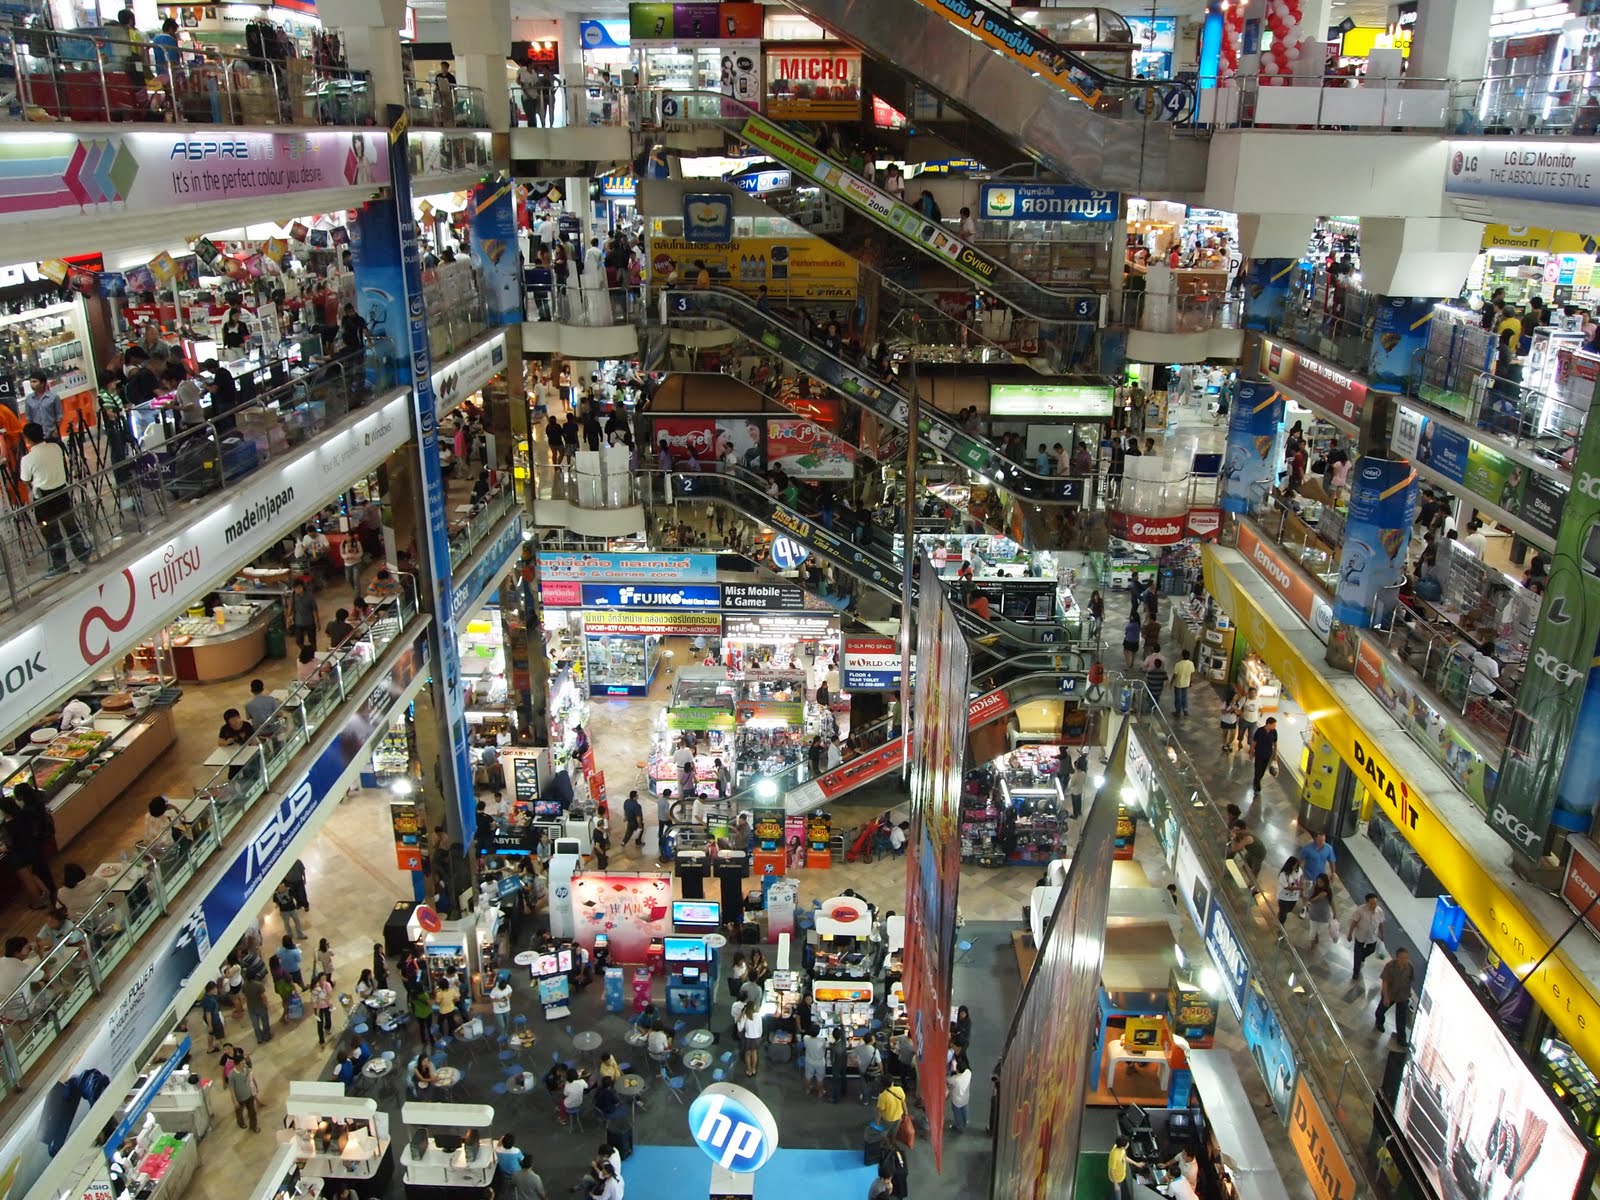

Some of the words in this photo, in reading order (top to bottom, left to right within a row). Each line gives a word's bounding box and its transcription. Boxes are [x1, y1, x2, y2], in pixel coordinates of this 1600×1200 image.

[972, 10, 985, 26] 1
[1400, 11, 1417, 24] leno
[780, 58, 848, 79] MICRO
[664, 103, 674, 114] 4
[1169, 94, 1180, 110] 4
[171, 142, 249, 160] ASPIRE
[1504, 151, 1517, 165] LG
[1537, 152, 1576, 168] Monitor
[1465, 156, 1478, 172] LG
[172, 170, 190, 194] It's
[191, 169, 202, 191] in
[203, 170, 220, 191] the
[222, 168, 256, 194] perfect
[258, 167, 285, 187] colour
[286, 169, 300, 188] you
[1490, 169, 1506, 182] THE
[1509, 170, 1557, 186] ABSOLUTE
[1559, 173, 1591, 188] STYLE
[868, 199, 890, 216] 2008
[1022, 190, 1112, 218] ดอกหญ้า
[1492, 236, 1528, 247] banana
[1529, 239, 1540, 247] IT
[679, 298, 687, 310] 3
[1079, 302, 1088, 314] 3
[684, 479, 692, 491] 2
[1063, 483, 1072, 495] 2
[1577, 472, 1600, 499] ac
[224, 484, 295, 545] madeinjapan
[150, 546, 200, 600] FUJITSU
[1253, 543, 1290, 589] lenovo
[453, 583, 469, 609] other
[633, 592, 682, 605] FUJIKO
[725, 586, 745, 596] Miss
[748, 586, 780, 596] Mobile
[725, 598, 733, 606] &
[734, 597, 766, 607] Games
[1043, 633, 1053, 642] M
[849, 658, 884, 667] WORLD
[1535, 647, 1583, 687] acer
[1063, 681, 1074, 690] M
[968, 693, 1001, 715] anDisk
[1354, 740, 1397, 808] DATA
[245, 771, 313, 885] ASUS
[1494, 804, 1542, 846] acer
[493, 837, 520, 845] ABYTE
[1572, 868, 1597, 899] leno
[556, 888, 567, 898] hp
[128, 963, 155, 997] POWER
[697, 1094, 763, 1169] hp
